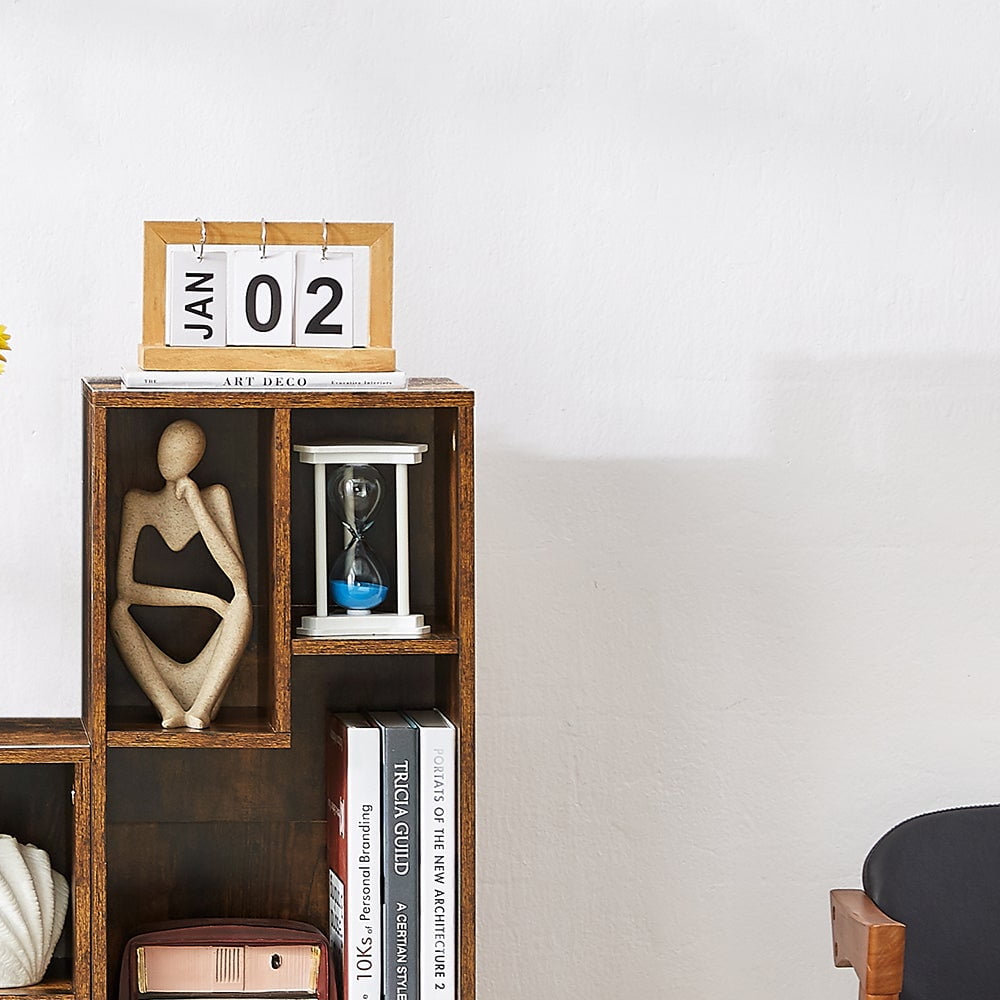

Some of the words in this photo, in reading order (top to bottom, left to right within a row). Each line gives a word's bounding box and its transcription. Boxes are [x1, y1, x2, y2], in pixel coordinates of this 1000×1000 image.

[184, 272, 214, 340] JAN
[222, 376, 255, 387] ART
[263, 376, 307, 387] DECO
[394, 760, 408, 818] TRICIA
[433, 749, 444, 802] PORTATS
[358, 804, 373, 857] Branding
[434, 807, 445, 823] OF
[434, 829, 445, 850] THE
[394, 823, 409, 876] GUILD
[434, 855, 445, 885] NEW
[359, 858, 373, 922] Personal
[396, 902, 407, 910] A
[364, 926, 373, 934] of
[396, 911, 407, 963] CERTIAN
[434, 889, 446, 977] ARCHITECTURE
[357, 936, 373, 981] 10Ks
